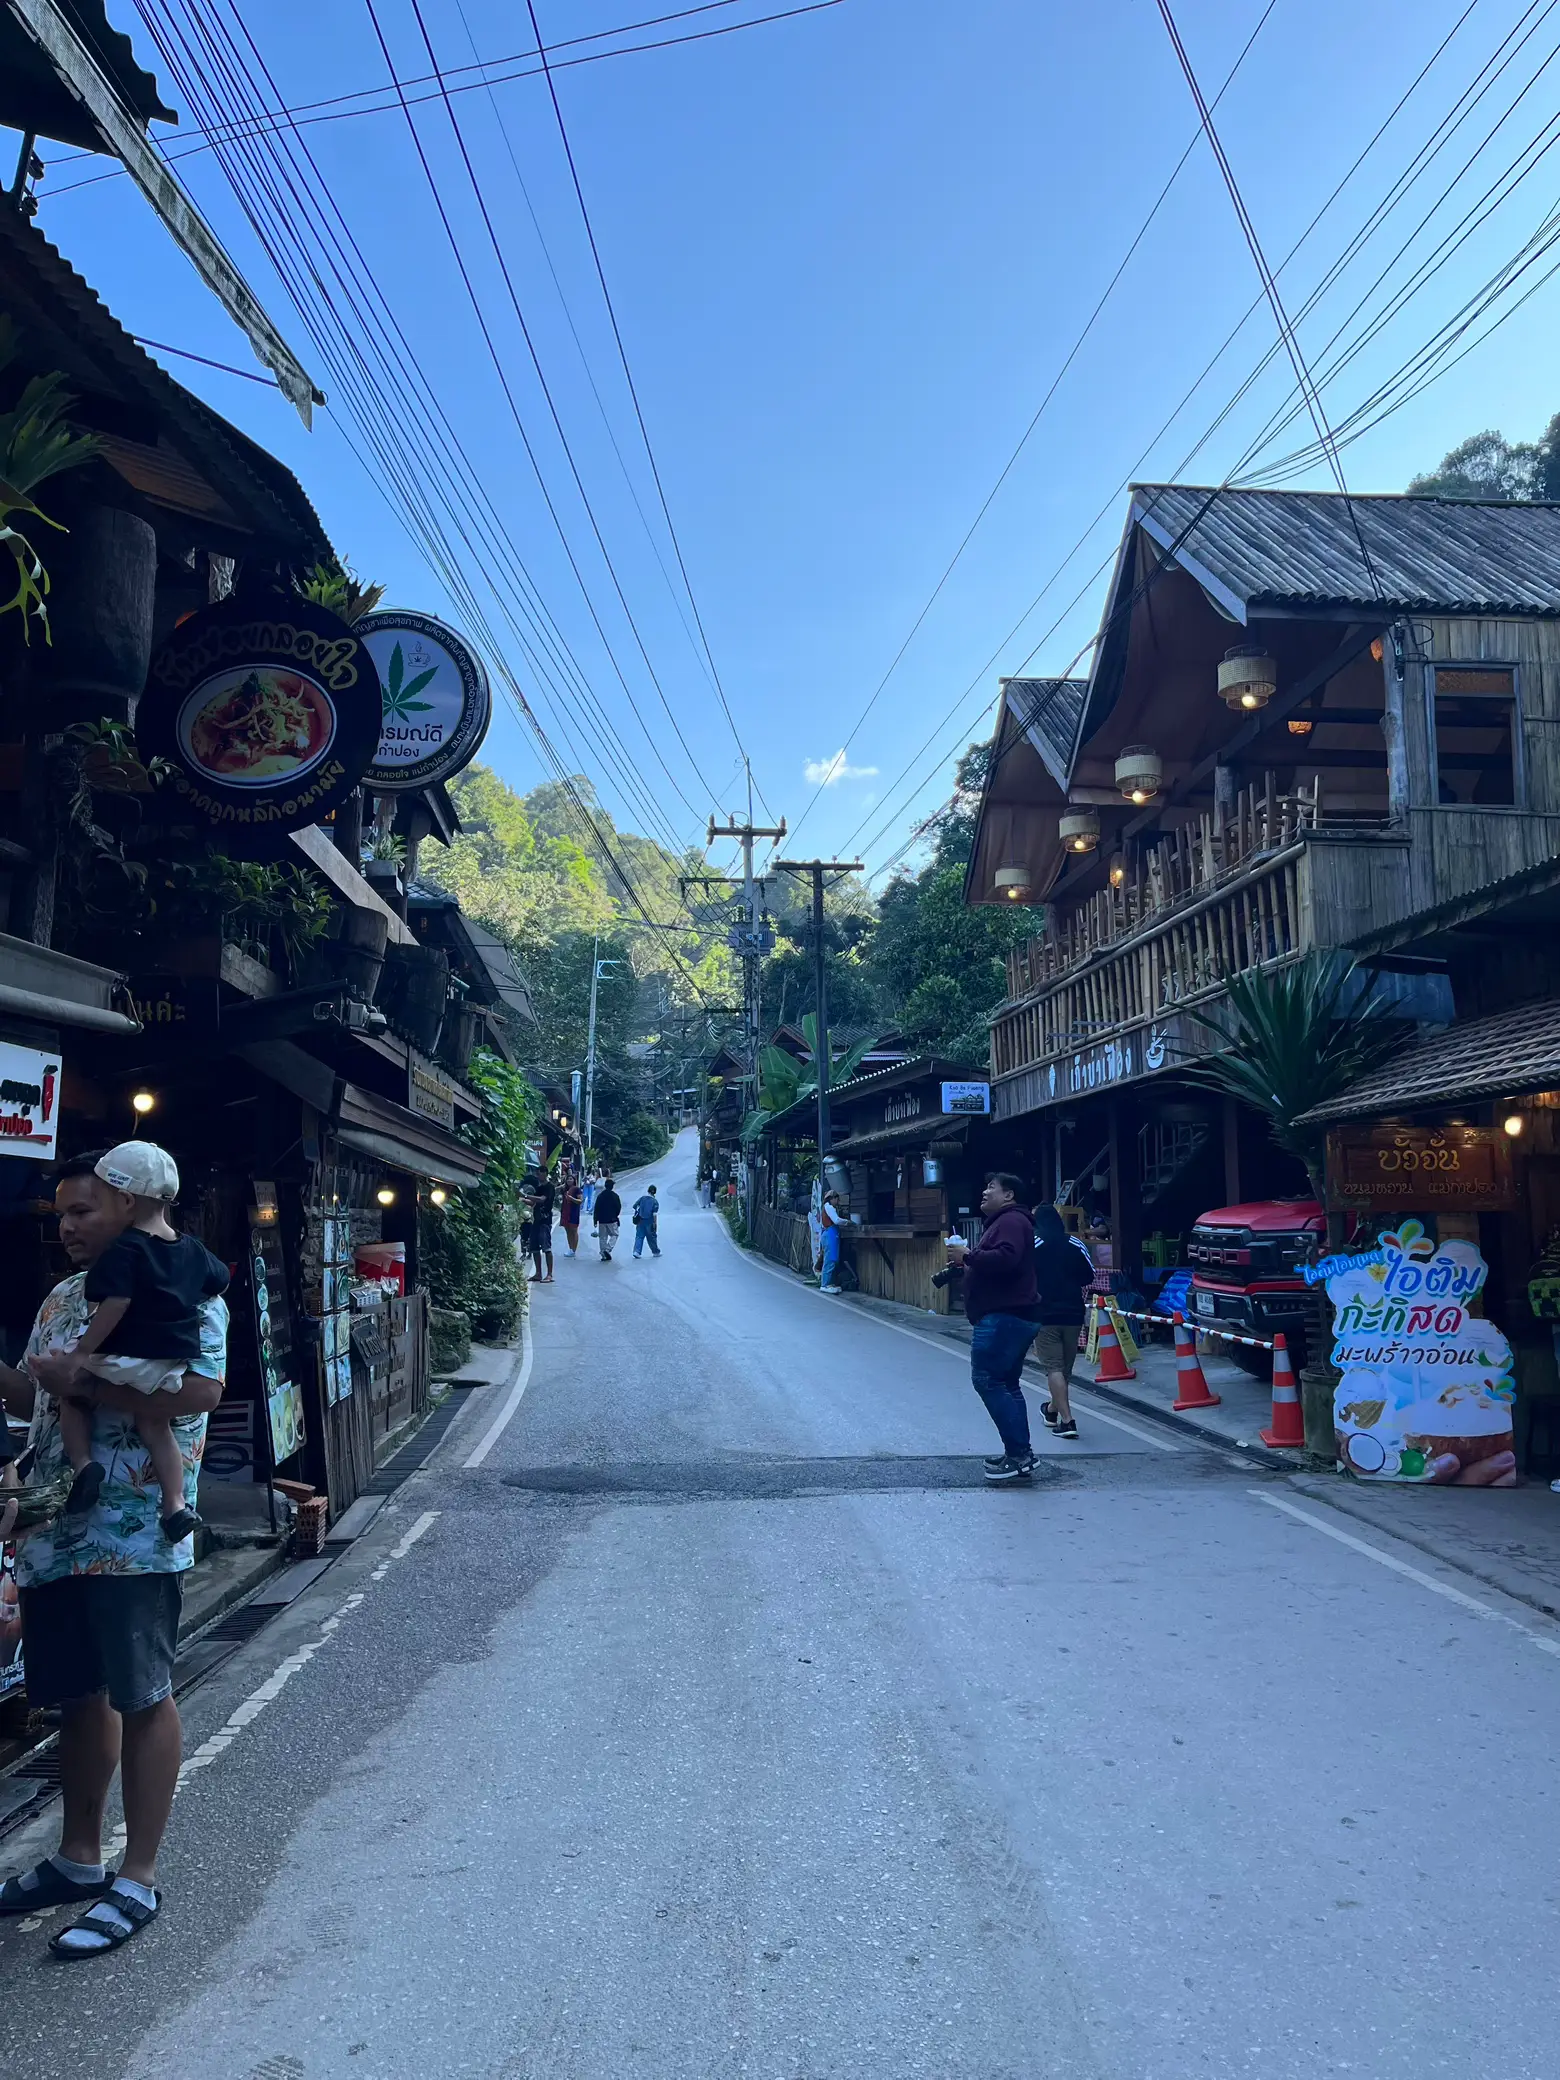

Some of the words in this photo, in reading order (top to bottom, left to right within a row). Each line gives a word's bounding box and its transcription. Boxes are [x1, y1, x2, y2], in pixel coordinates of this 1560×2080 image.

[380, 723, 443, 742] ารมณ์ดี
[379, 742, 420, 757] กำปอง
[1344, 1181, 1415, 1195] ขนมหวาน
[1186, 1243, 1240, 1265] FORD
[1384, 1249, 1481, 1293] ไอติม
[1338, 1297, 1463, 1334] กะทิสด
[1336, 1341, 1476, 1365] มะพร้าวอ่อน
